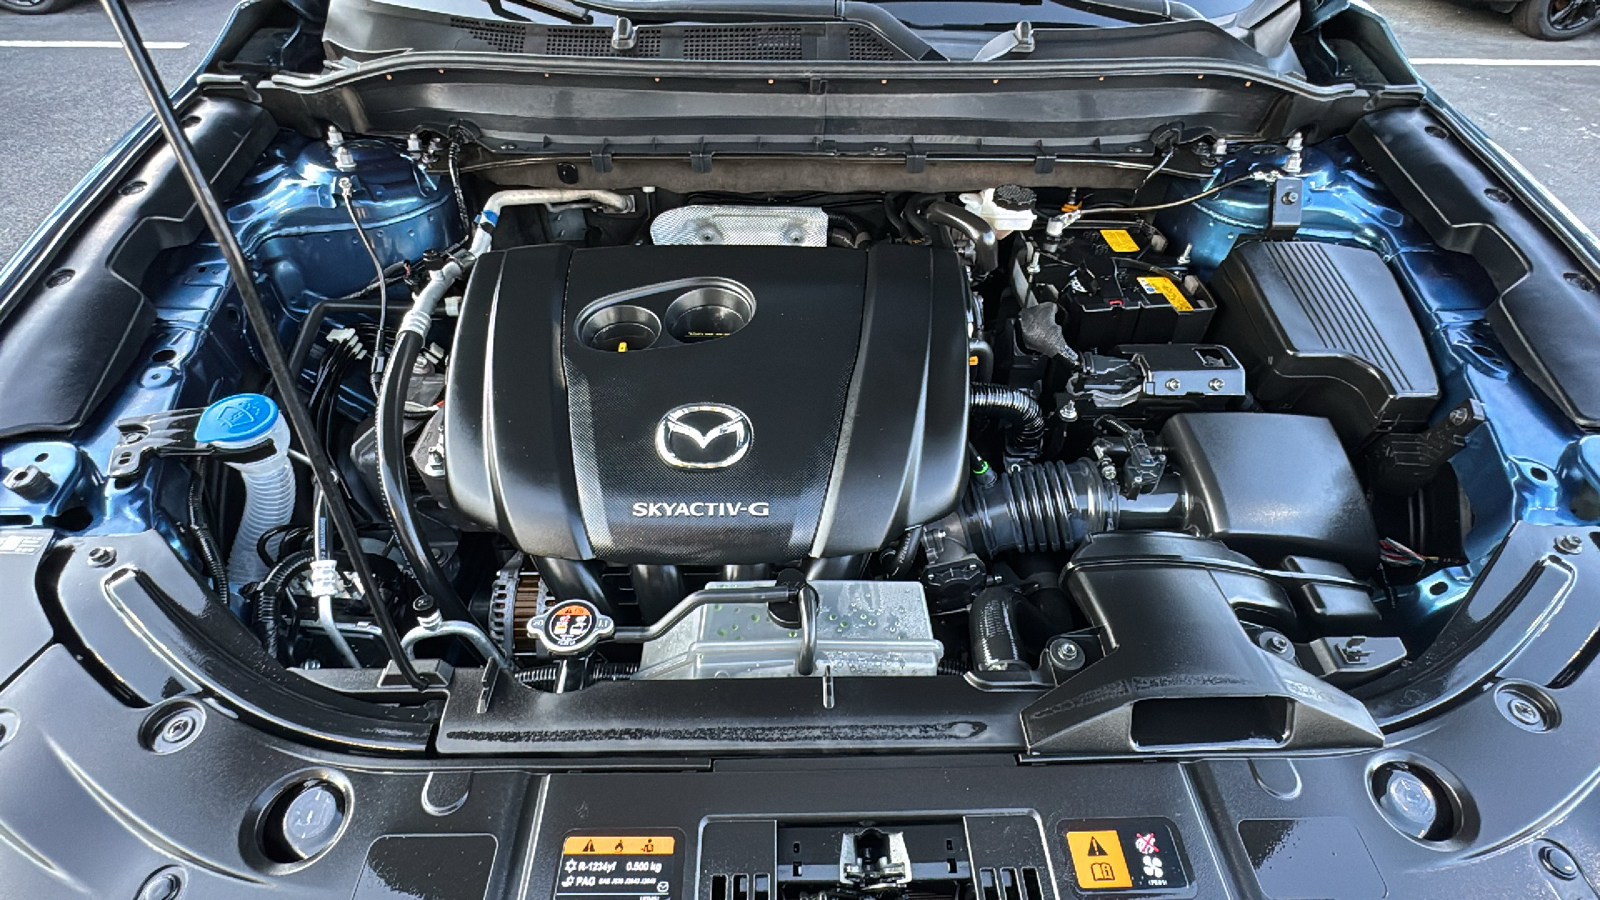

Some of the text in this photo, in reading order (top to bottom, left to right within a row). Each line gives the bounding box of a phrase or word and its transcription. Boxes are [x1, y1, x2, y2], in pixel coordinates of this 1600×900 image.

[632, 502, 769, 517] SKYACTIV-G
[650, 861, 662, 873] kg
[576, 876, 596, 886] PAG
